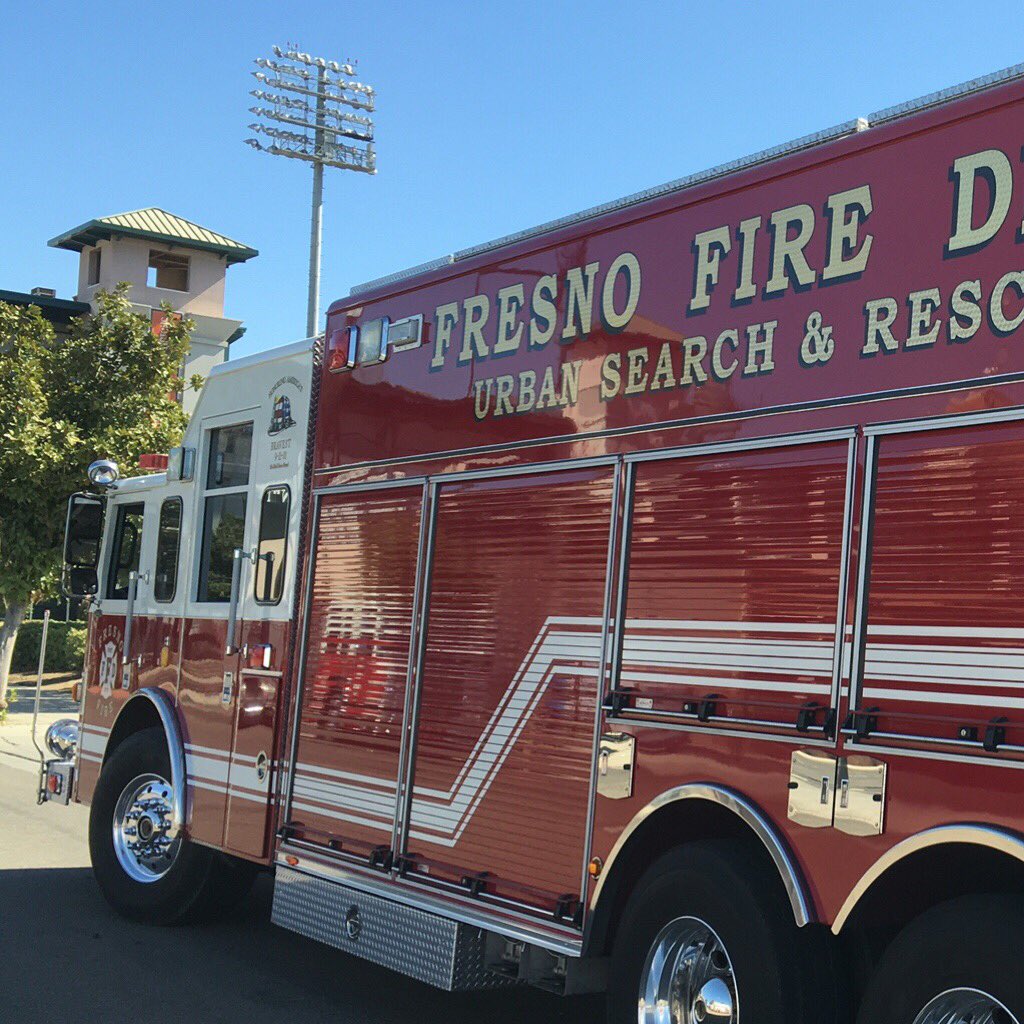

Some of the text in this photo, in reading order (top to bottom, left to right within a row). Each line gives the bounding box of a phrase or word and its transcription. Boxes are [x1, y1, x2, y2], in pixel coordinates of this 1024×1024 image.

[431, 253, 642, 368] FRESNO
[688, 185, 874, 312] FIRE
[473, 360, 583, 421] URBAN
[601, 320, 778, 400] SEARCH
[800, 311, 835, 365] &
